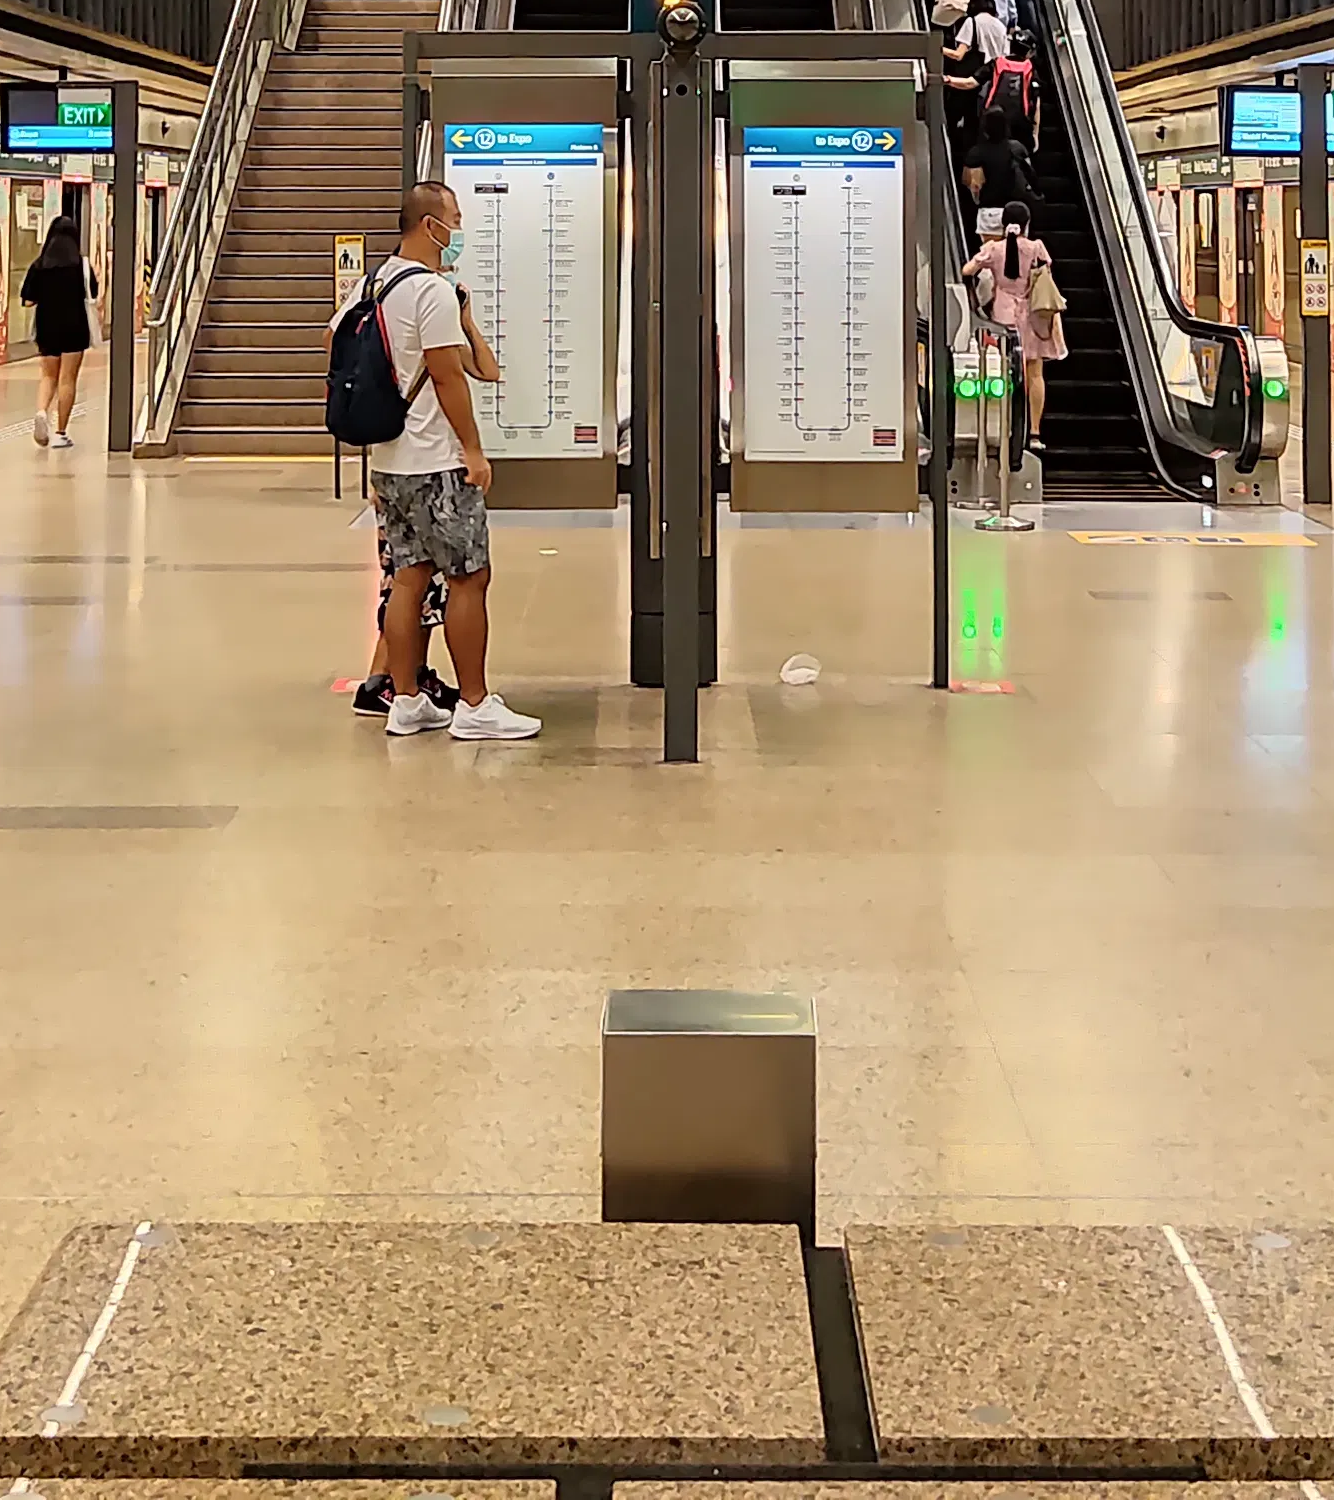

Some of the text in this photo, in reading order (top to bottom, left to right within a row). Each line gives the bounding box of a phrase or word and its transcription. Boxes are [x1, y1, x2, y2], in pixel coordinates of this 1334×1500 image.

[64, 107, 97, 125] EXIT
[478, 133, 532, 146] 12 to Expo
[815, 135, 869, 148] to Expo 12
